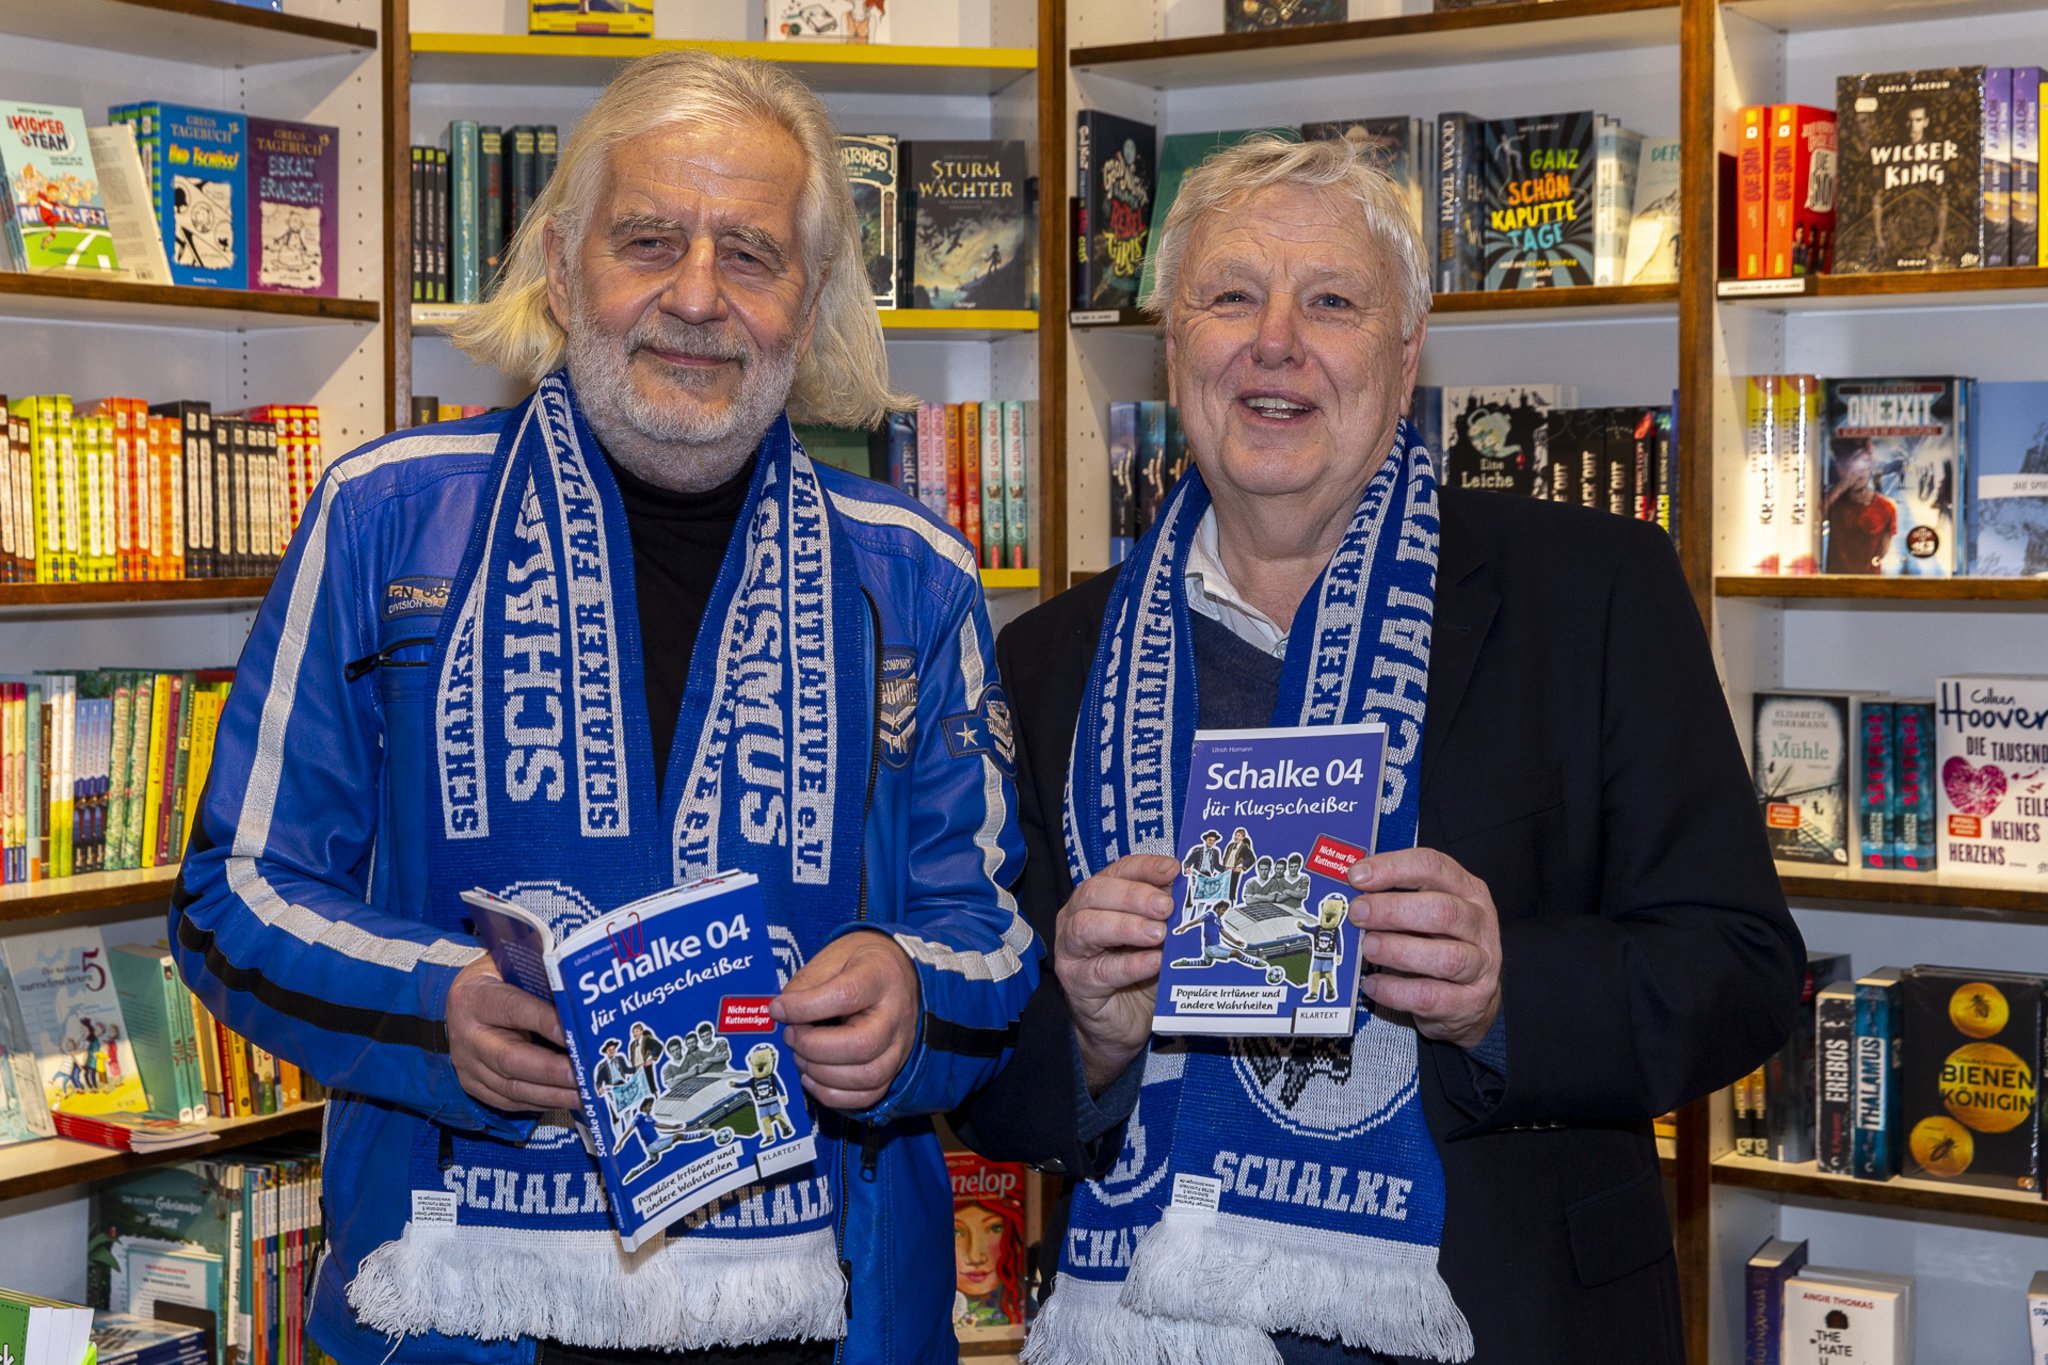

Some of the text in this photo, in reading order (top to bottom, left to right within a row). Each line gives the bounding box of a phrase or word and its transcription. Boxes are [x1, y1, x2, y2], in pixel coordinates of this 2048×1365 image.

[30, 133, 69, 151] TEAM
[170, 122, 233, 144] TAGEBUCH
[257, 138, 324, 156] TAGEBUCH
[1441, 120, 1455, 172] WOOD
[1870, 140, 1960, 166] WICKER
[931, 160, 1001, 180] STURM
[1529, 147, 1580, 171] GANZ
[918, 179, 1013, 198] WÄCHTER
[1884, 163, 1945, 190] KING
[1441, 173, 1455, 222] HAZEL
[1507, 172, 1571, 206] SCHÖN
[1490, 199, 1578, 232] KAPUTTE
[1506, 221, 1564, 252] TAGE
[1480, 458, 1505, 471] Eine
[1461, 470, 1515, 489] Leiche
[1938, 682, 2048, 734] Hoover
[1772, 718, 1829, 729] HERRMANN
[1212, 746, 1231, 754] Ulrich
[1771, 740, 1830, 761] Mühle
[1966, 736, 1987, 757] DIE
[1205, 758, 1364, 791] Schalke 04
[1203, 797, 1358, 821] für Klugscheißer
[1991, 820, 2041, 843] MEINES
[1319, 845, 1336, 858] Nicht
[1949, 842, 2006, 866] HERZENS
[82, 947, 106, 992] 5
[578, 934, 702, 1005] Schalke
[706, 913, 751, 950] 04
[591, 953, 754, 1035] für Klugscheißer
[1176, 987, 1280, 1000] Populäre Irrtümer und
[1180, 999, 1273, 1011] andere Wahrheiten
[725, 1015, 771, 1026] Kuttenträger
[727, 1005, 746, 1015] Nicht
[746, 1006, 759, 1015] nur
[1300, 1011, 1338, 1020] KLARTEXT
[1824, 1038, 1849, 1104] EREBOS
[1860, 1038, 1881, 1128] THALAMUS
[1941, 1064, 2035, 1091] BIENEN
[565, 1029, 608, 1158] Schalke 04 für Klugscheißer
[1941, 1086, 2035, 1113] KÖNIGIN
[762, 1143, 802, 1162] KLARTEXT
[637, 1147, 736, 1206] Populäre Irrtümer und
[646, 1161, 733, 1214] andere Wahrheiten
[951, 1167, 1017, 1198] nelop
[1212, 1149, 1414, 1222] SCHALKE
[1802, 1292, 1875, 1310] ANGIE THOMAS
[1815, 1329, 1842, 1343] THE
[1818, 1343, 1853, 1358] HATE
